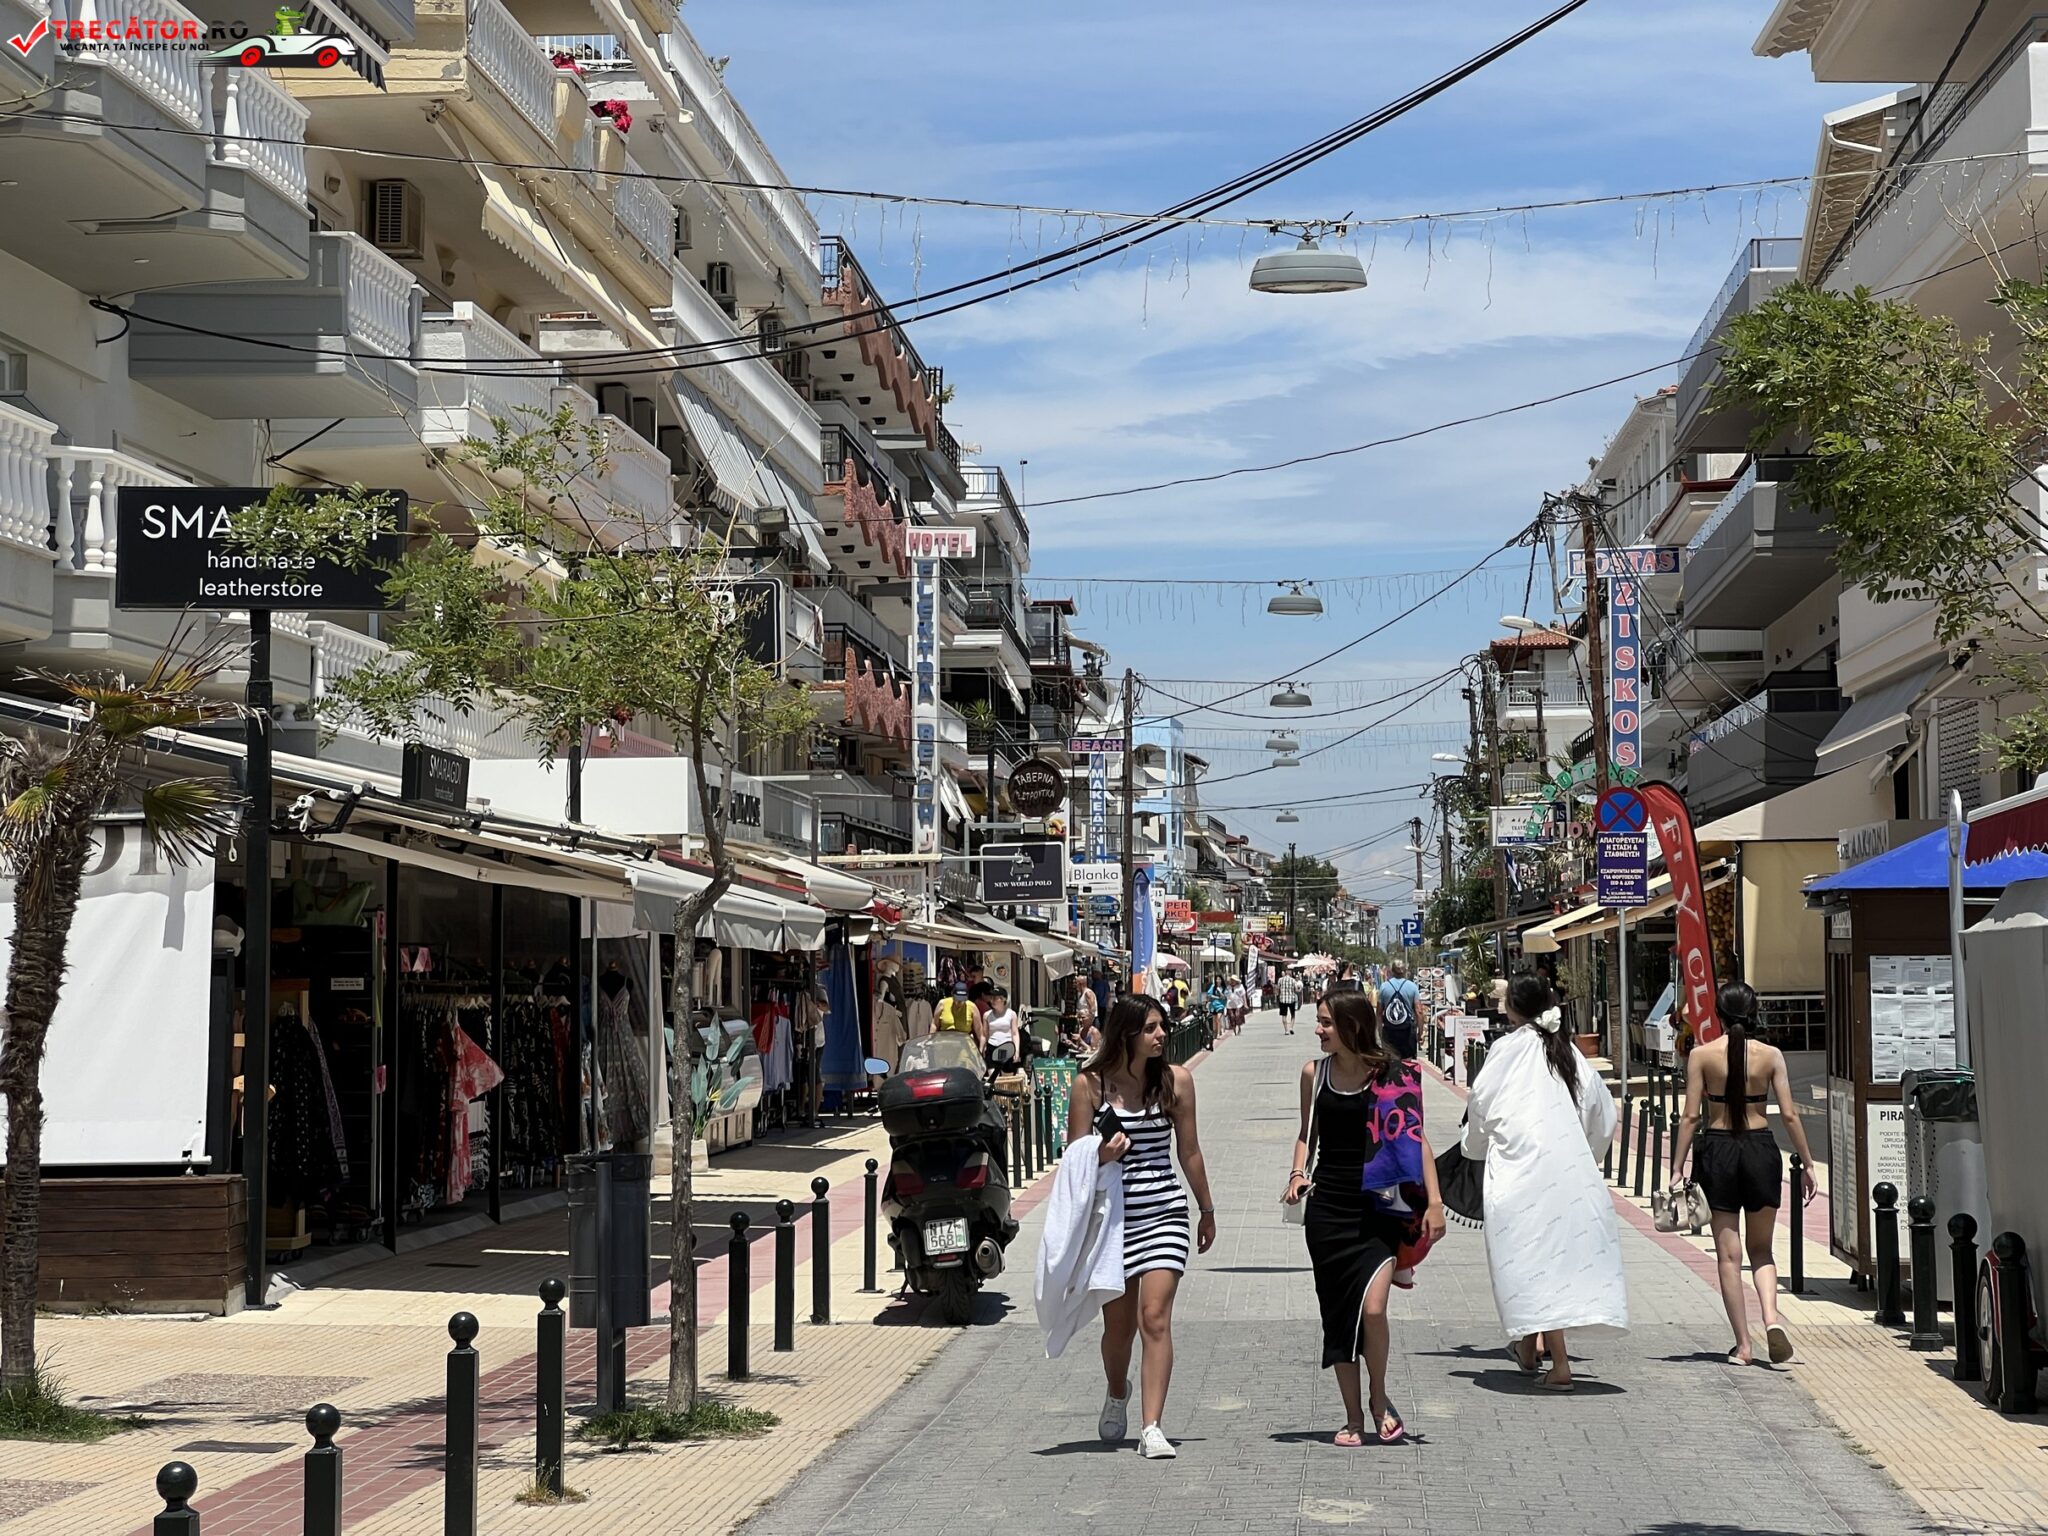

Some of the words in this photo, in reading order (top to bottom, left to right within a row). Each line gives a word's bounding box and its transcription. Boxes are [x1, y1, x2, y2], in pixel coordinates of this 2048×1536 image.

[909, 533, 972, 557] HOTEL
[1572, 550, 1676, 574] KOSTAS
[200, 578, 323, 597] leatherstore
[917, 559, 934, 705] ELEKTRA
[1613, 582, 1638, 767] ZISKOS
[1071, 740, 1123, 752] BEACH
[429, 754, 463, 785] SMARAGDI
[917, 723, 935, 829] BEACH
[1014, 772, 1054, 786] ΤΑΒΕΡΝΑ
[1074, 868, 1118, 880] Blanka
[1407, 921, 1417, 934] P
[1880, 1111, 1904, 1121] PIRA
[931, 1234, 954, 1248] 668
